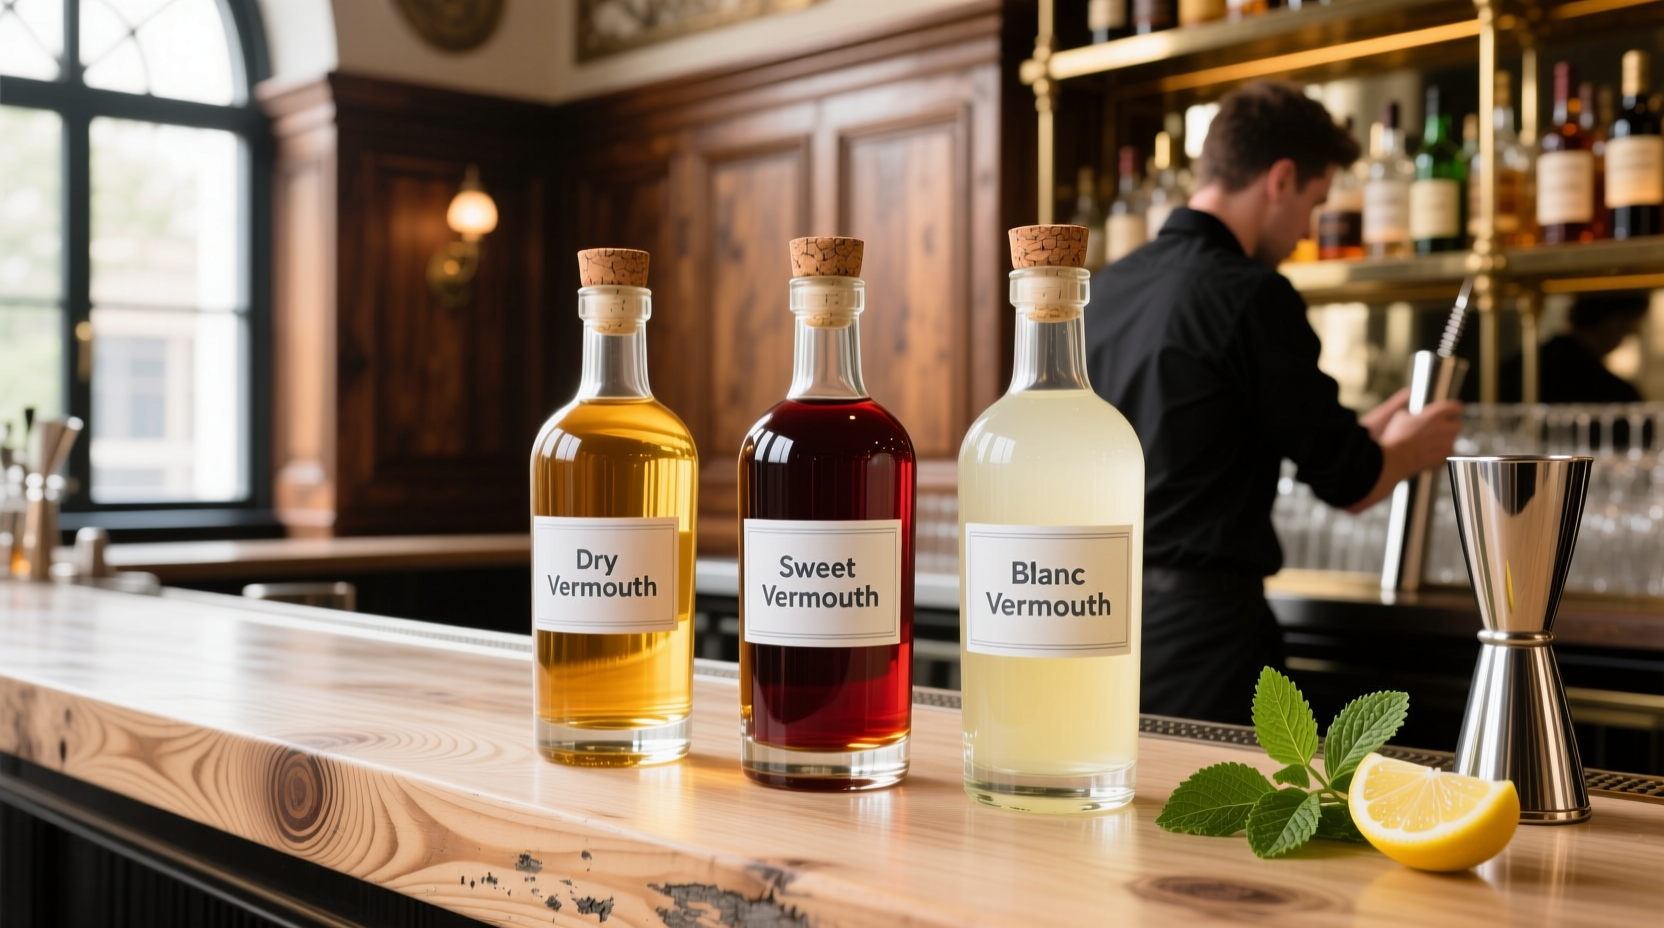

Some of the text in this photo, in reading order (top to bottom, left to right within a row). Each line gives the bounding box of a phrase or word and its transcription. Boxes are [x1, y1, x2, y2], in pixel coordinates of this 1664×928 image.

[575, 548, 618, 577] Dry
[779, 555, 857, 579] Sweet
[1012, 561, 1086, 586] Blanc
[547, 574, 658, 598] Vermouth
[761, 584, 879, 609] Vermouth
[985, 591, 1111, 618] Vermouth
